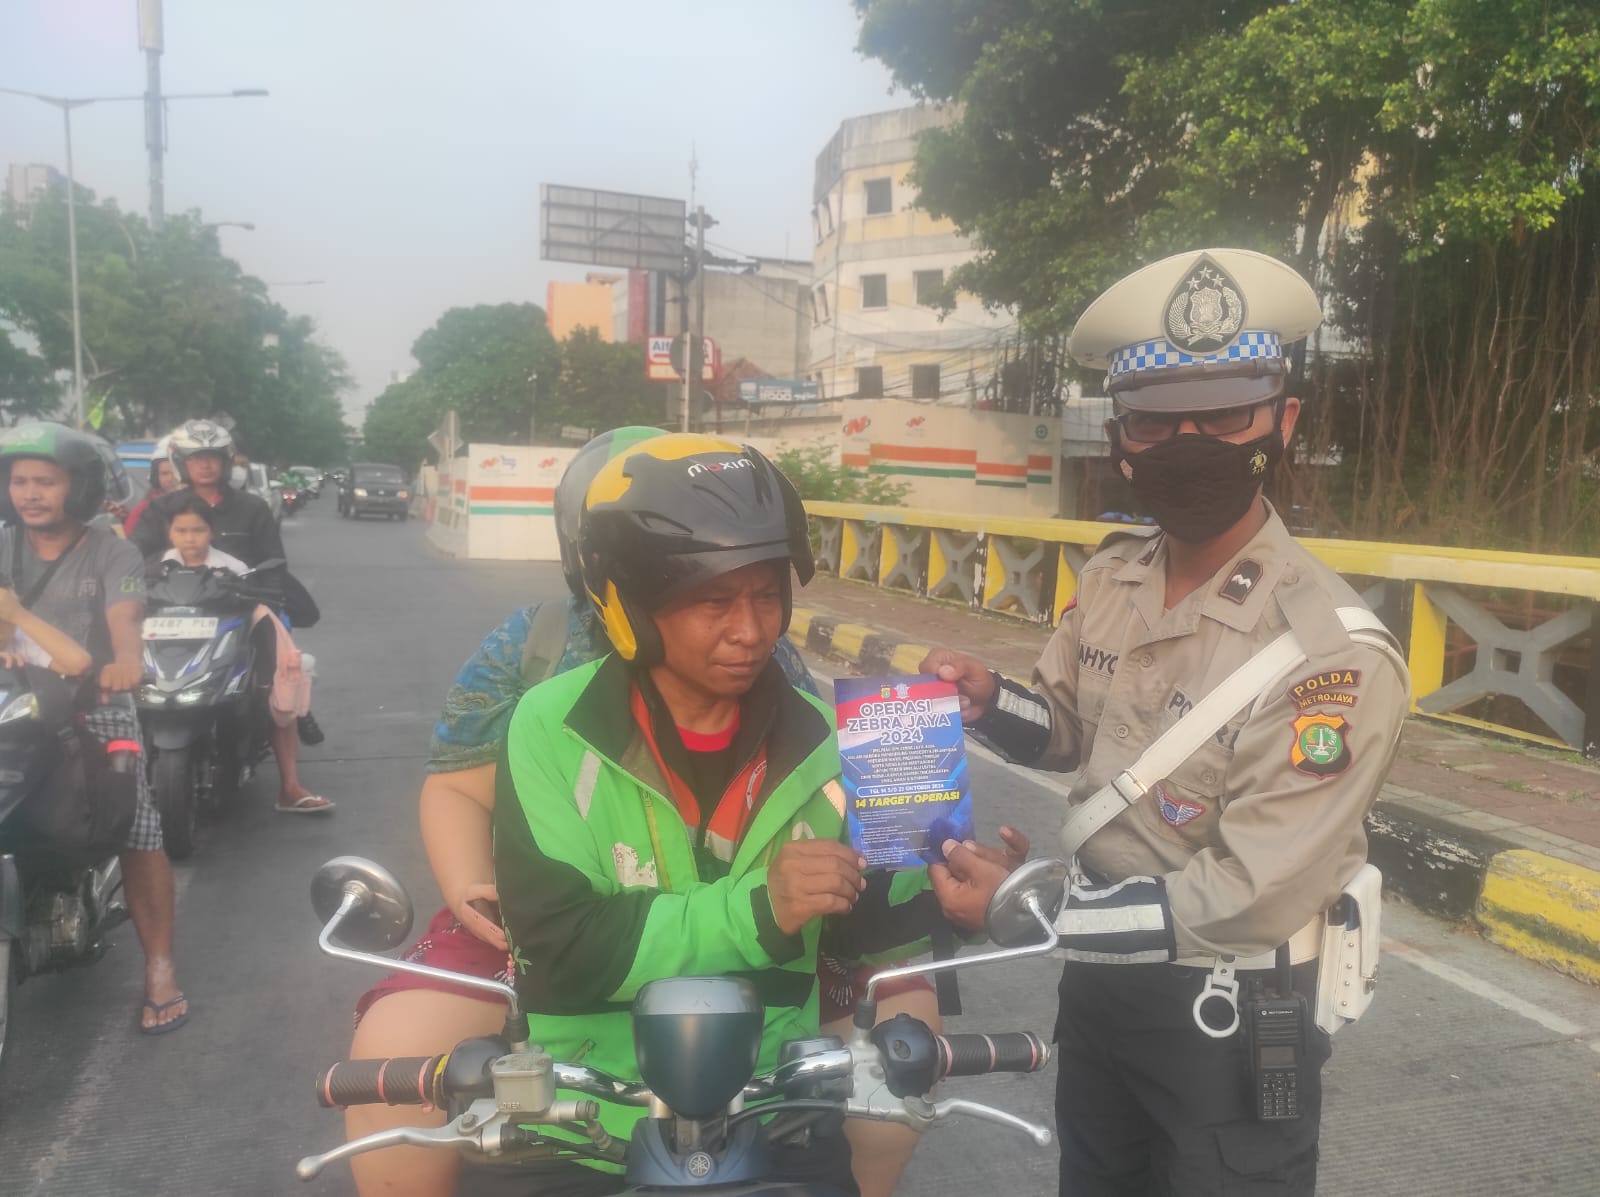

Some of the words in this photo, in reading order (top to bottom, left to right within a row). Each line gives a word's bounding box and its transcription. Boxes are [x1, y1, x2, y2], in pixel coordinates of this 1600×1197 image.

[1293, 671, 1354, 697] POLDA
[860, 700, 932, 718] OPERASI
[1299, 692, 1354, 708] METROJAYA
[847, 716, 905, 733] ZEBRA
[907, 712, 951, 729] JAYA
[881, 728, 923, 745] 2024
[855, 799, 867, 809] 14
[869, 795, 912, 807] TARGET
[914, 791, 960, 803] OPERASI
